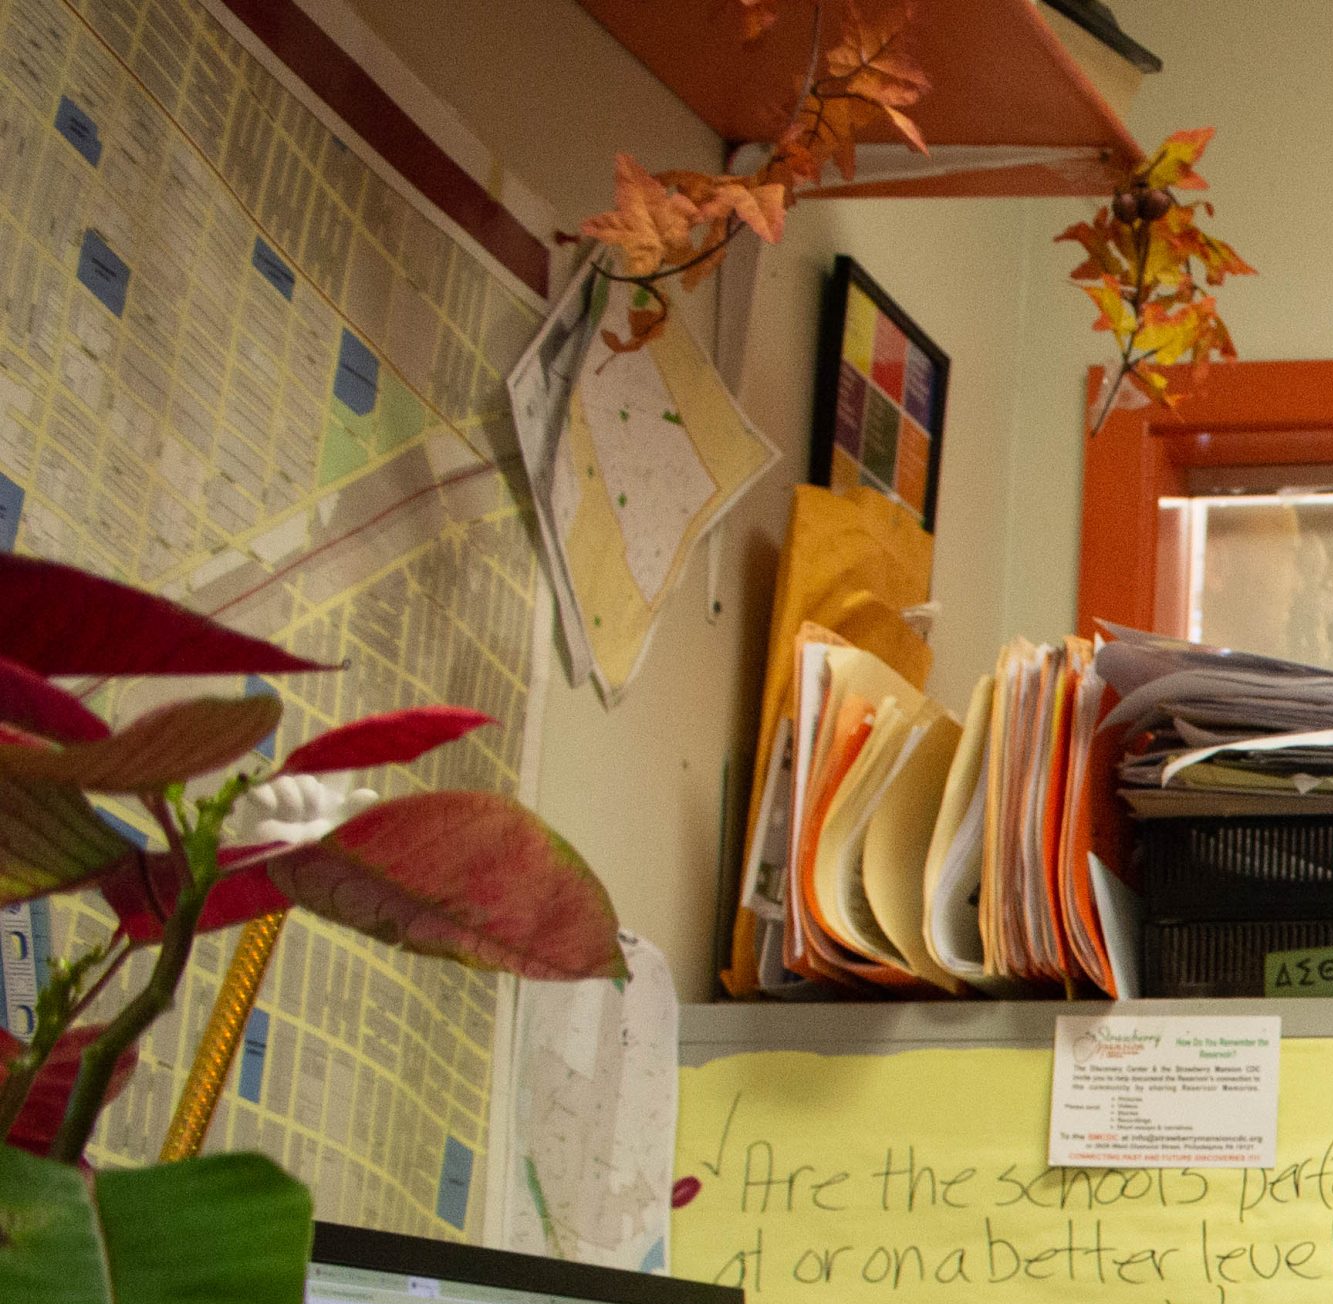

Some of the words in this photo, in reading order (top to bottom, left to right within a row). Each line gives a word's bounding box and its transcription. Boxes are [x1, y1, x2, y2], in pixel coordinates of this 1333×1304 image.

[742, 1140, 850, 1212] Are
[872, 1145, 976, 1212] the
[793, 1246, 854, 1284] or
[862, 1246, 925, 1291] on
[934, 1248, 972, 1284] a
[985, 1216, 1180, 1284] better
